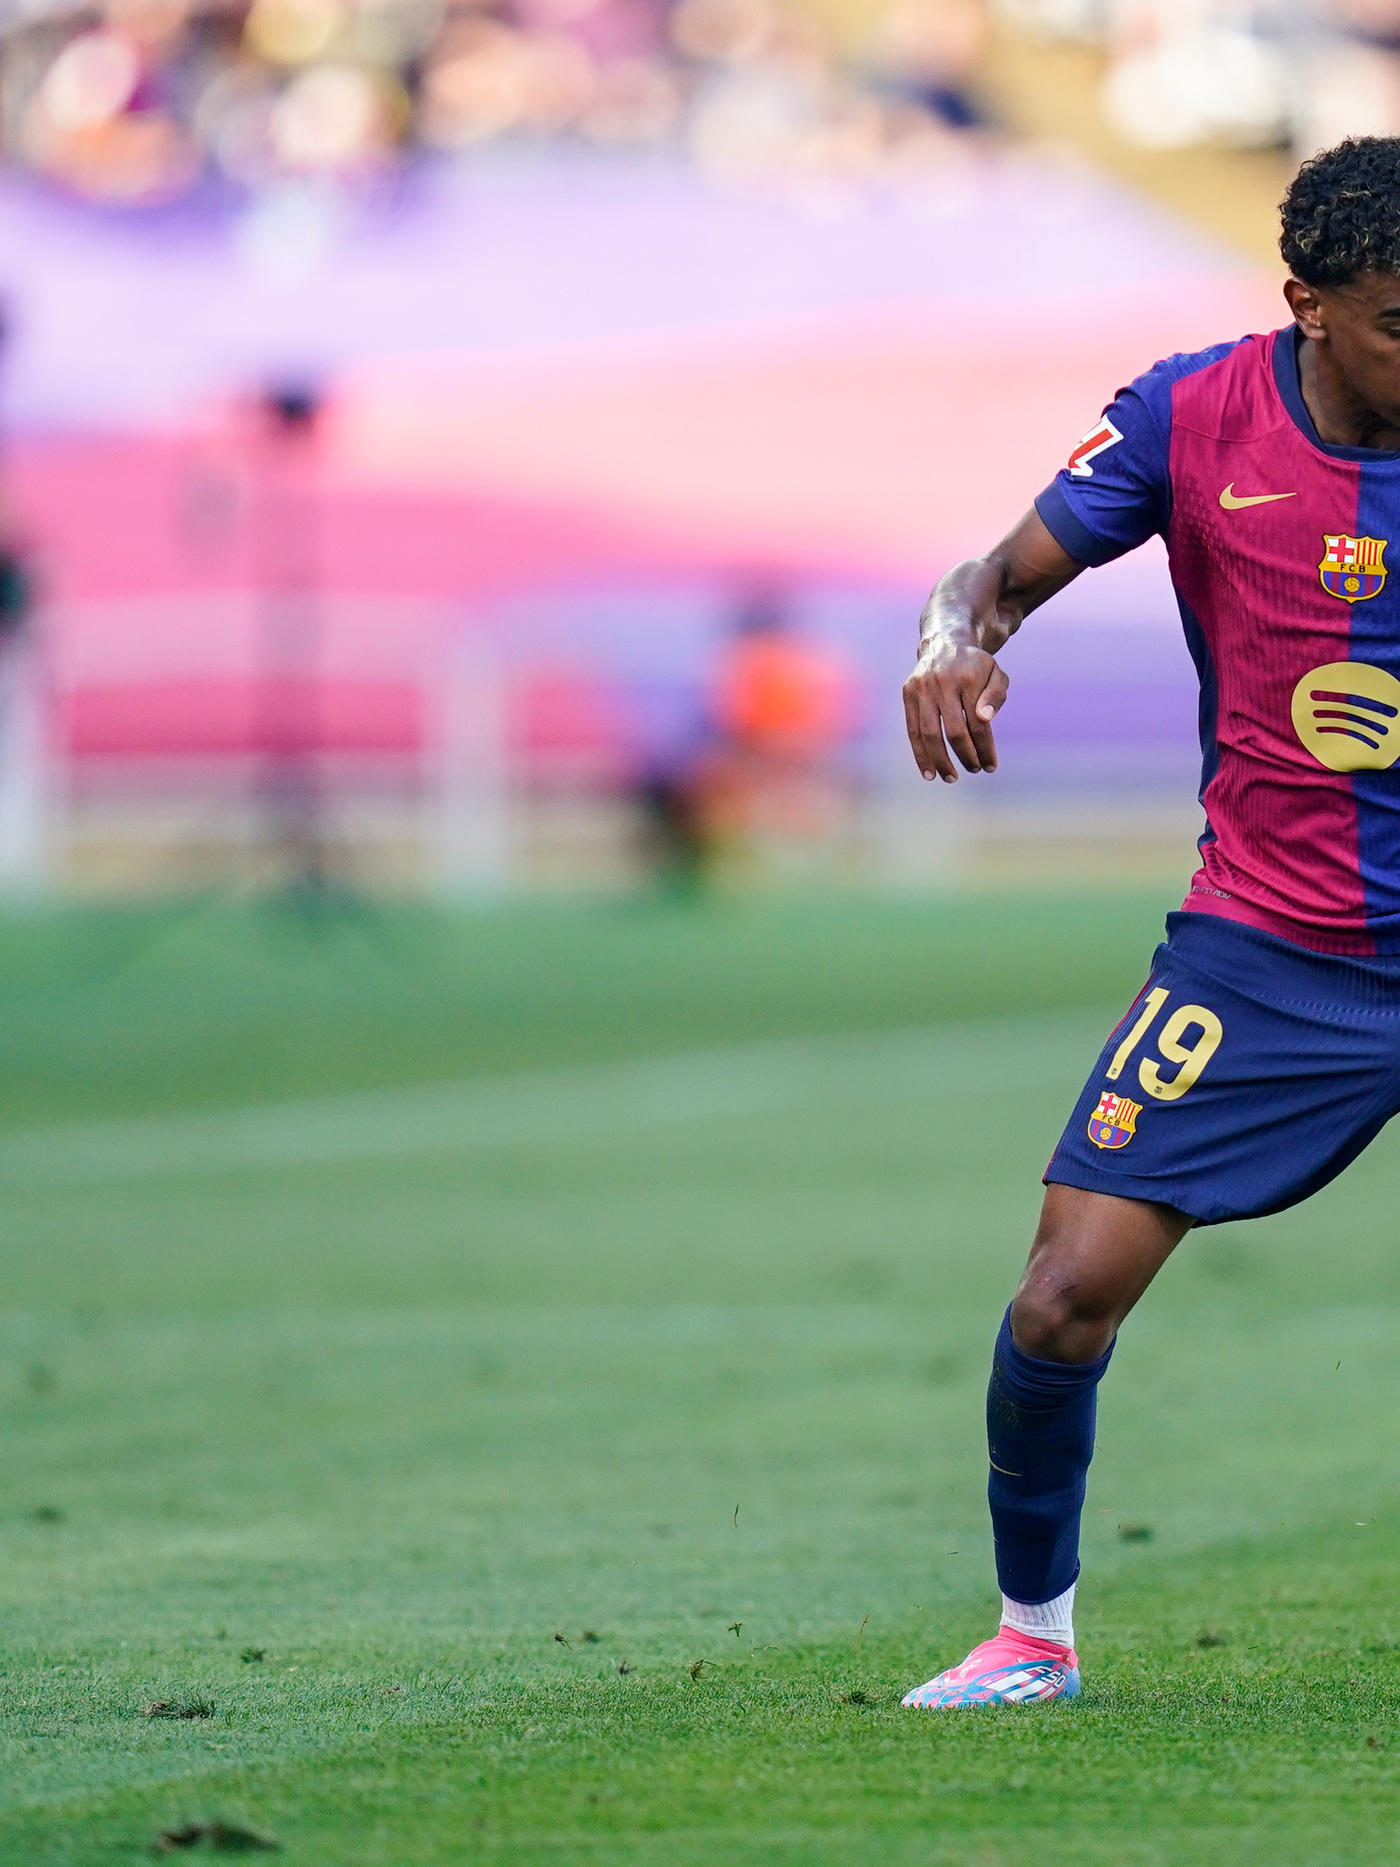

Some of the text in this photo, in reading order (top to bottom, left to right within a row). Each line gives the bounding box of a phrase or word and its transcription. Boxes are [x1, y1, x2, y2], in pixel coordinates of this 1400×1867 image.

[1340, 564, 1366, 573] FCB
[1105, 986, 1223, 1101] 19
[1101, 1114, 1121, 1127] FCB
